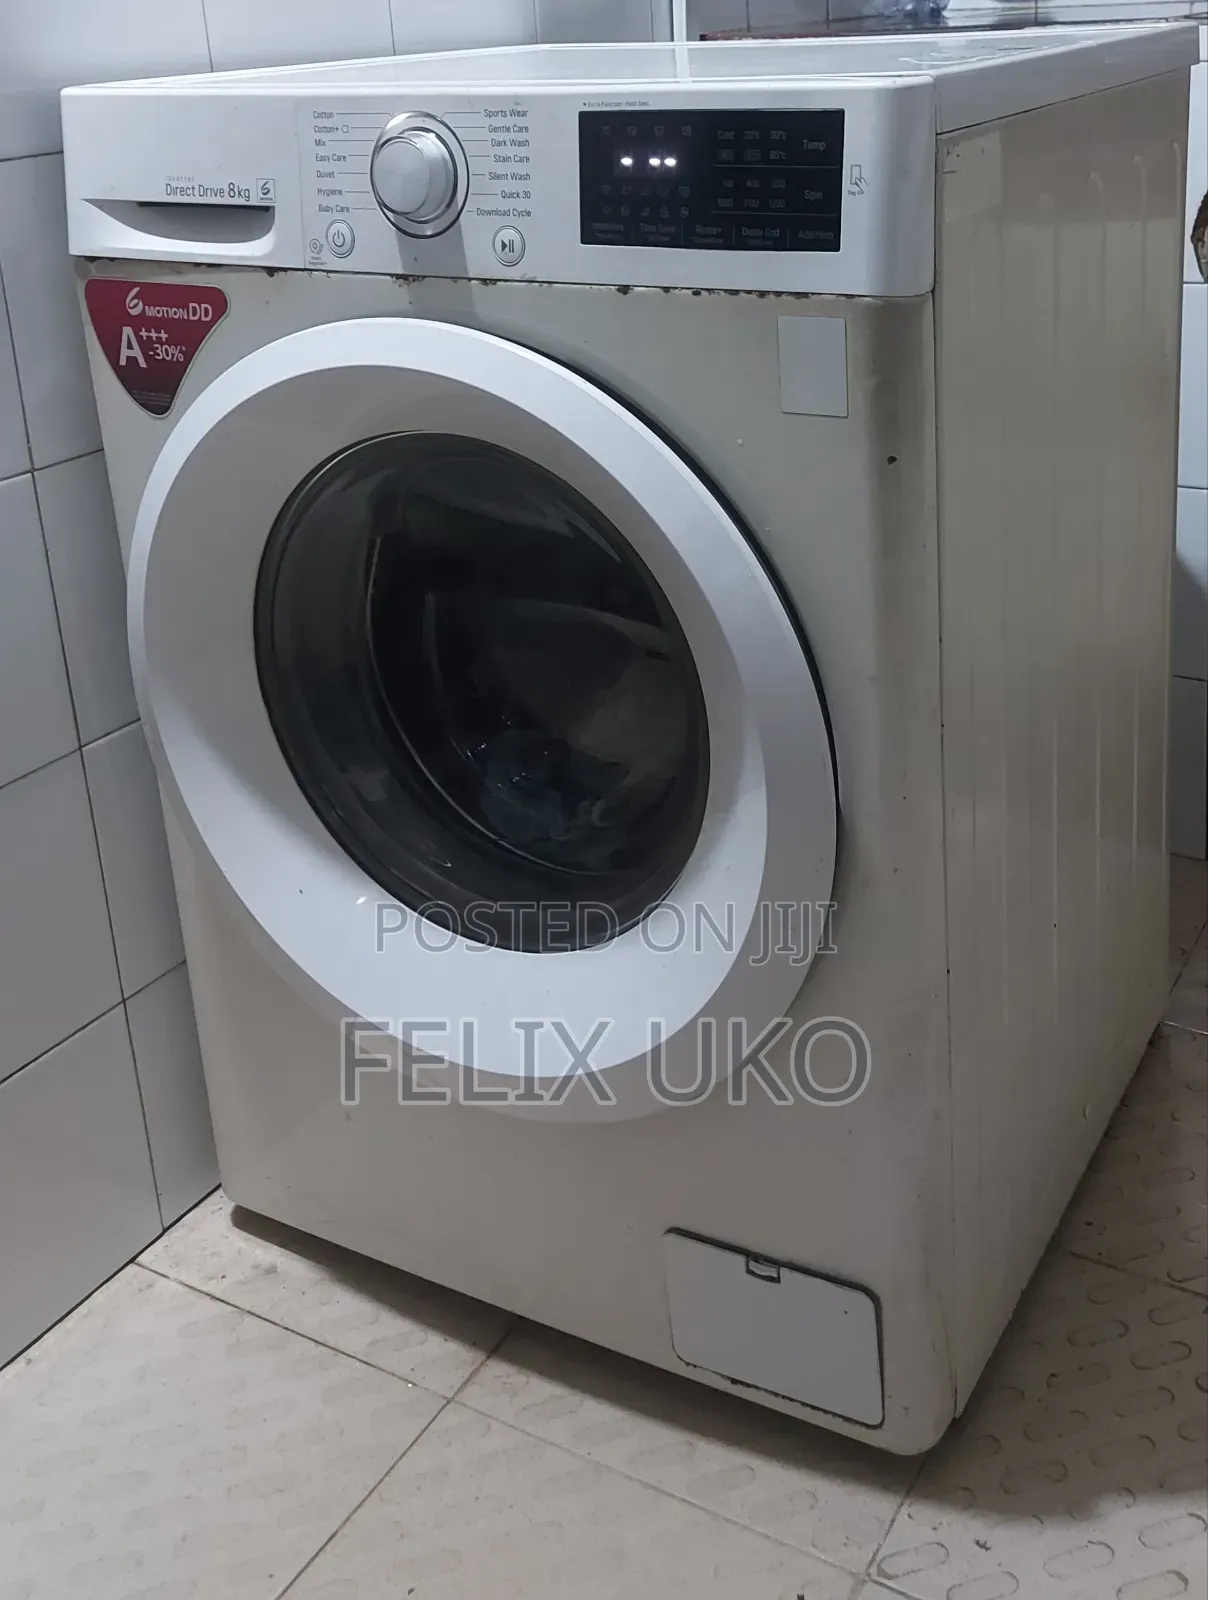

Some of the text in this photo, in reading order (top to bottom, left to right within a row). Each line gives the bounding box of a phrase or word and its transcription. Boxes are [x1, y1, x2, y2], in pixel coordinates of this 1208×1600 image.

[312, 110, 335, 119] Cotton
[483, 108, 529, 119] Sports Wear
[313, 124, 339, 134] Cotton+
[488, 124, 529, 133] Gentle Care
[314, 138, 326, 147] Mix
[491, 138, 530, 147] Dark Wash
[315, 153, 347, 163] Easy Care
[493, 153, 530, 163] Stain Care
[316, 169, 336, 179] Duvet
[488, 171, 531, 181] Silent Wash
[165, 183, 196, 197] Direct
[198, 184, 225, 199] Drive
[317, 187, 343, 197] Hygiene
[500, 189, 531, 199] Quick 30
[803, 189, 823, 202] Spin
[318, 203, 350, 214] Baby Care
[476, 207, 532, 218] Download Cycle
